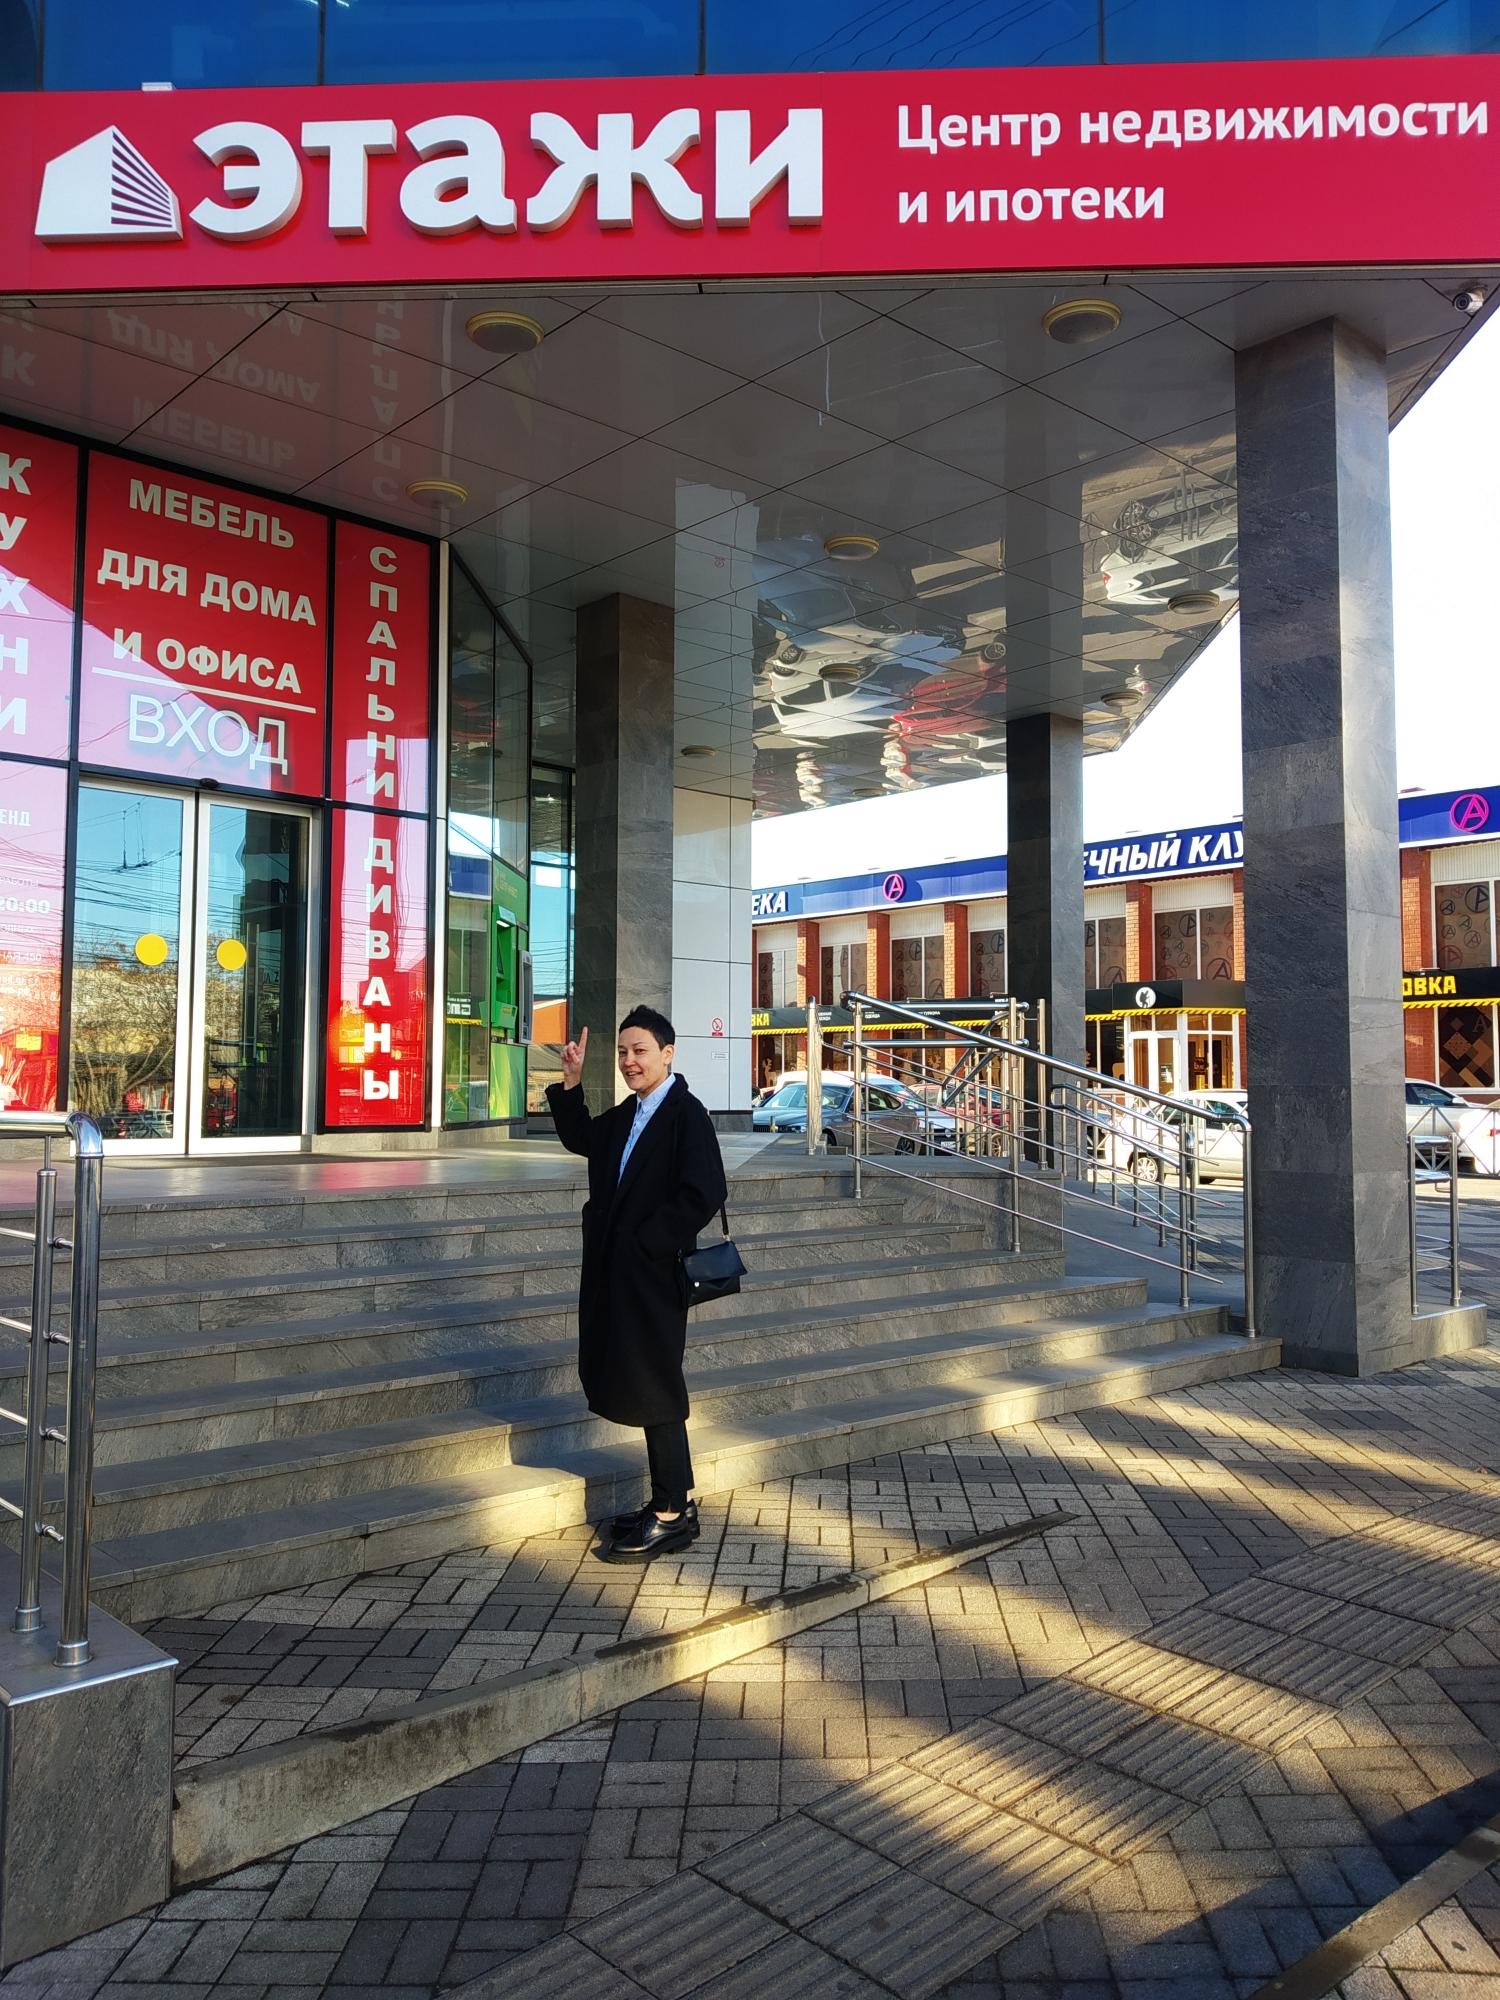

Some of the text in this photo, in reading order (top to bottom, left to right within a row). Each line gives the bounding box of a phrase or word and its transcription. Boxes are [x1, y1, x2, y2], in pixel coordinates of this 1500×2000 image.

[898, 101, 1488, 156] Центр недвижимости
[189, 107, 824, 241] этажи
[898, 185, 1165, 223] и ипотеки
[129, 478, 294, 548] МЕБЕЛЬ
[97, 548, 317, 626] ДЛЯ ДОМА
[113, 627, 301, 694] И ОФИСА
[128, 694, 288, 775] ВХОД
[363, 546, 399, 1101] СПАЛЬНИ ДИВАНЫ
[1084, 833, 1182, 875] ЧНЫЙ
